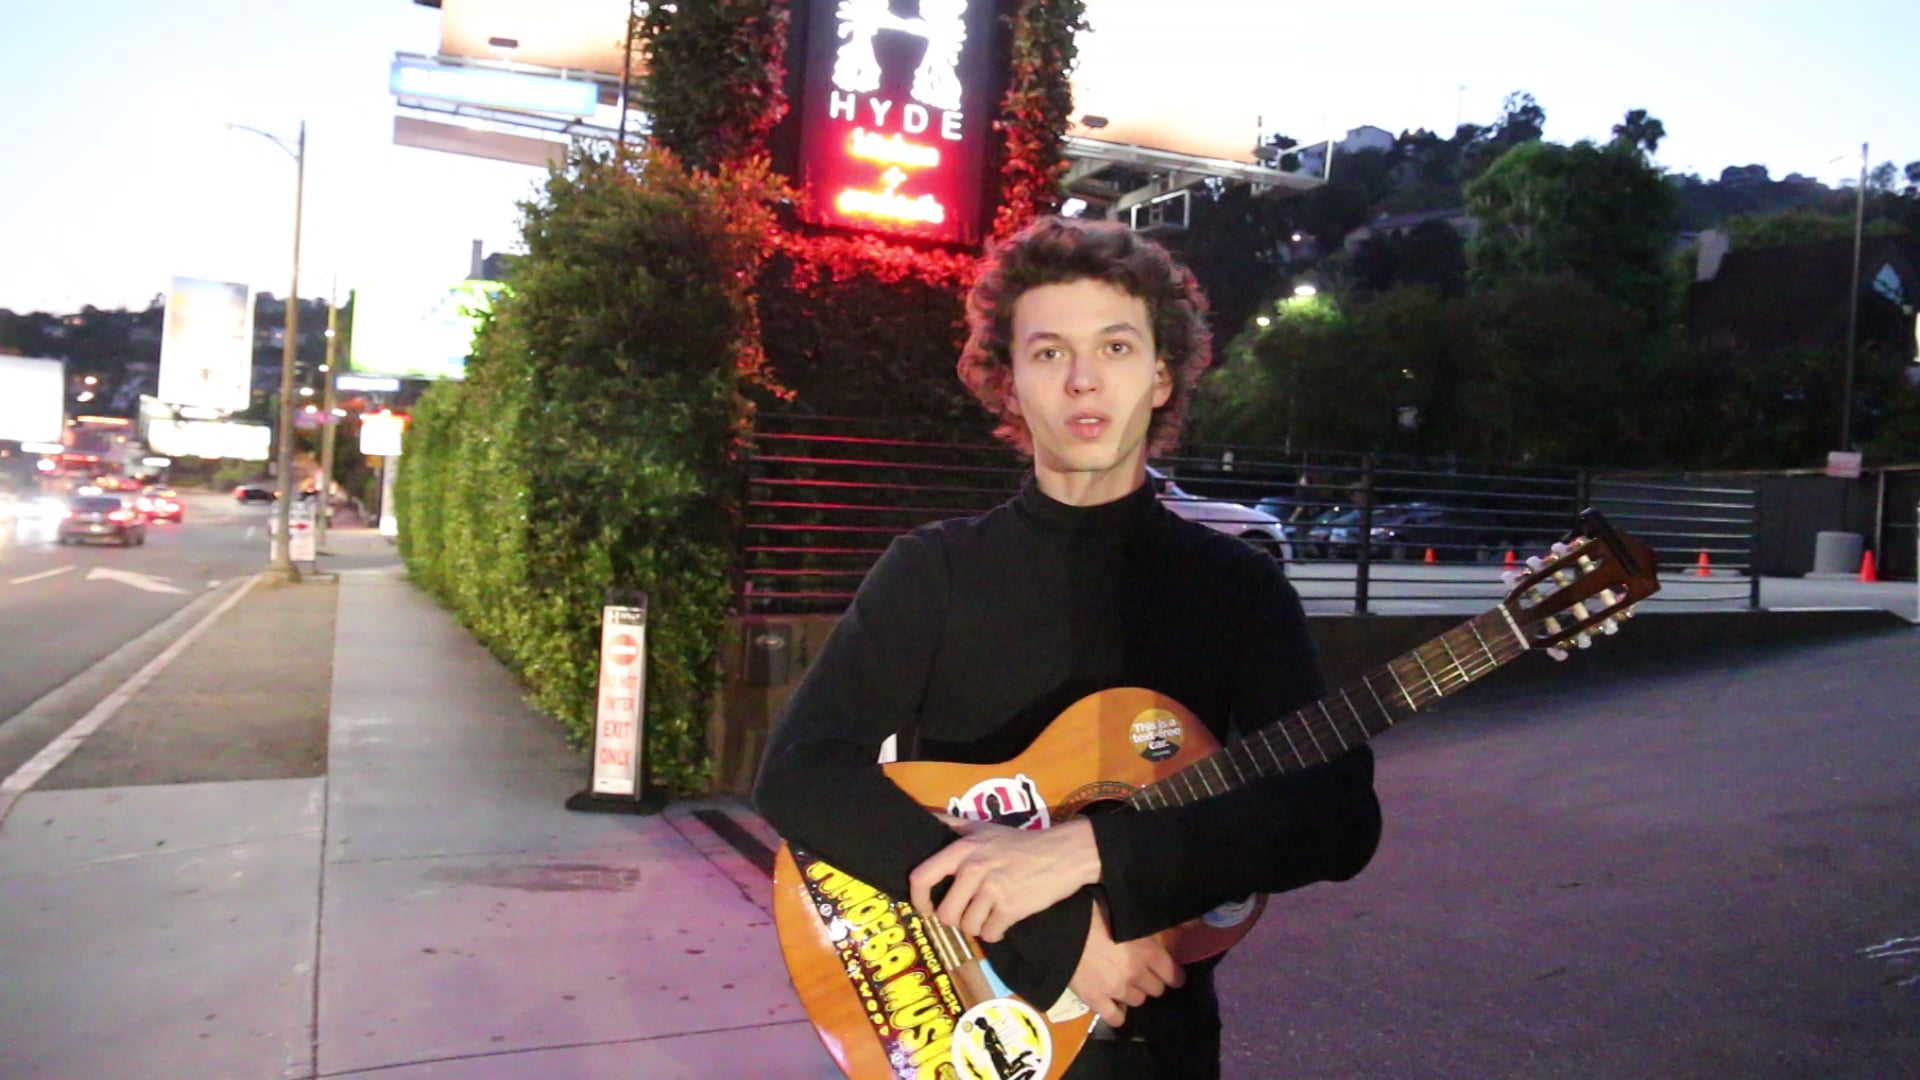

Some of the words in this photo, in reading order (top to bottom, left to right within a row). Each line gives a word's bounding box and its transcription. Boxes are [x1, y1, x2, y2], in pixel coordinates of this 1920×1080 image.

[829, 90, 964, 140] HYDE
[603, 696, 635, 711] ENTER
[603, 720, 632, 738] EXIT
[1133, 721, 1157, 733] This
[599, 747, 632, 766] ONLY
